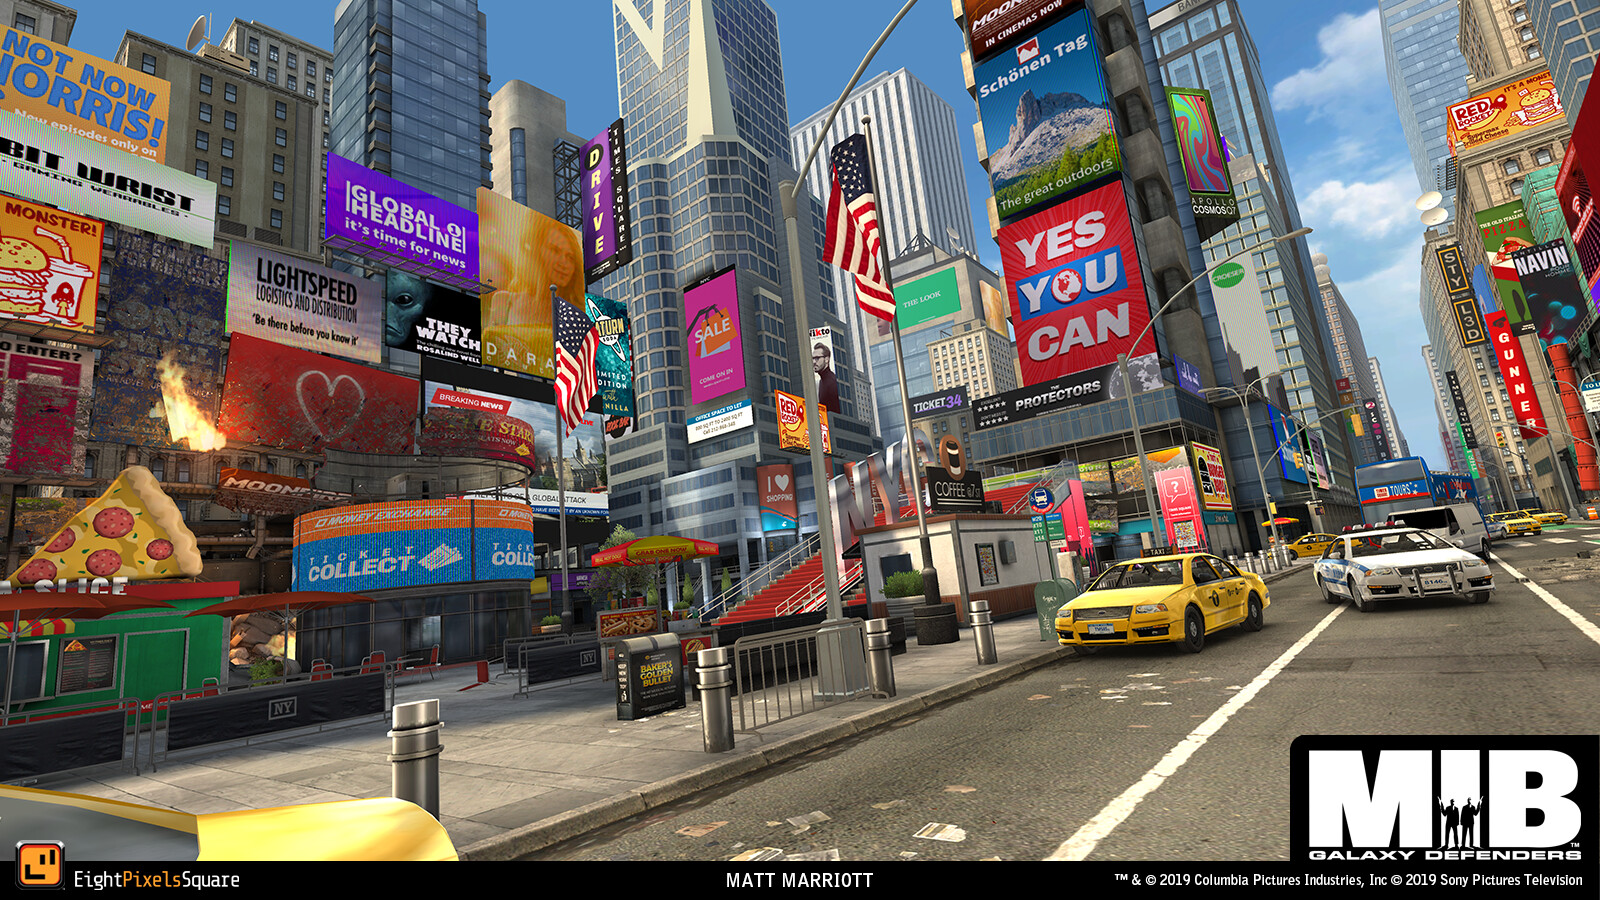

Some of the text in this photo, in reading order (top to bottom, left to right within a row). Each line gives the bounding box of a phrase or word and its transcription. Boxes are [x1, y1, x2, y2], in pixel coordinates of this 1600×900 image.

[985, 0, 1063, 48] IN CINEMAS NOW
[1, 29, 157, 112] NOT NOW
[979, 33, 1089, 98] Schönen Tag
[1504, 83, 1516, 94] IT'S
[1455, 101, 1489, 120] RED
[15, 108, 157, 158] Now episodes only on
[1467, 126, 1499, 140] Supermax
[1485, 128, 1509, 140] Cheese
[613, 127, 622, 175] TIMES
[13, 161, 181, 217] GAMING WEARABLES
[77, 161, 196, 212] WRIST
[1000, 196, 1021, 211] The
[1024, 184, 1054, 204] great
[1056, 157, 1113, 188] outdoors
[351, 184, 441, 232] GLOBAL
[588, 148, 605, 256] DRIVE
[5, 202, 98, 238] MONSTER!
[616, 185, 627, 243] SQUARE
[1480, 212, 1524, 229] THE OLD ITALIAN
[351, 199, 463, 254] HEADLINE
[1483, 219, 1527, 239] PIZZA
[345, 217, 466, 269] it's time for news
[1014, 210, 1107, 269] YES
[1512, 245, 1570, 277] NAVIN
[256, 257, 358, 306] LIGHTSPEED
[1019, 252, 1118, 313] YOU
[1545, 268, 1571, 279] HOMME
[256, 284, 358, 324] LOGISTICS AND DISTRIBUTION
[903, 290, 941, 309] THE LOOK
[267, 316, 289, 331] there
[290, 321, 315, 338] before
[316, 330, 331, 343] you
[331, 329, 351, 344] know
[425, 317, 472, 339] THEY
[596, 318, 625, 336] ATURN
[694, 317, 732, 344] SALE
[1027, 301, 1130, 361] CAN
[415, 325, 481, 352] WATCH
[16, 343, 82, 362] ENTER?
[417, 344, 459, 360] ROSALIND
[597, 370, 628, 381] IMITED
[597, 379, 628, 390] DITION
[699, 374, 715, 386] COME
[715, 370, 725, 379] ON
[725, 367, 734, 376] IN
[1498, 333, 1537, 428] GUNNER
[439, 393, 504, 411] BREAKING NEWS
[1015, 380, 1101, 412] PROTECTORS
[695, 413, 710, 421] OFFICE
[711, 408, 726, 416] SPACE
[780, 398, 796, 416] RED
[532, 495, 559, 504] GLOBAL
[766, 494, 793, 503] SHOPPING
[935, 481, 966, 497] COFFEE
[1390, 485, 1411, 496] TOURS
[310, 546, 414, 566] TICKET
[308, 555, 416, 583] COLLECT
[582, 652, 595, 664] NY
[640, 660, 673, 673] BAKER'S
[640, 667, 674, 680] GOLDEN
[643, 675, 672, 687] BULLET
[274, 701, 294, 715] NY
